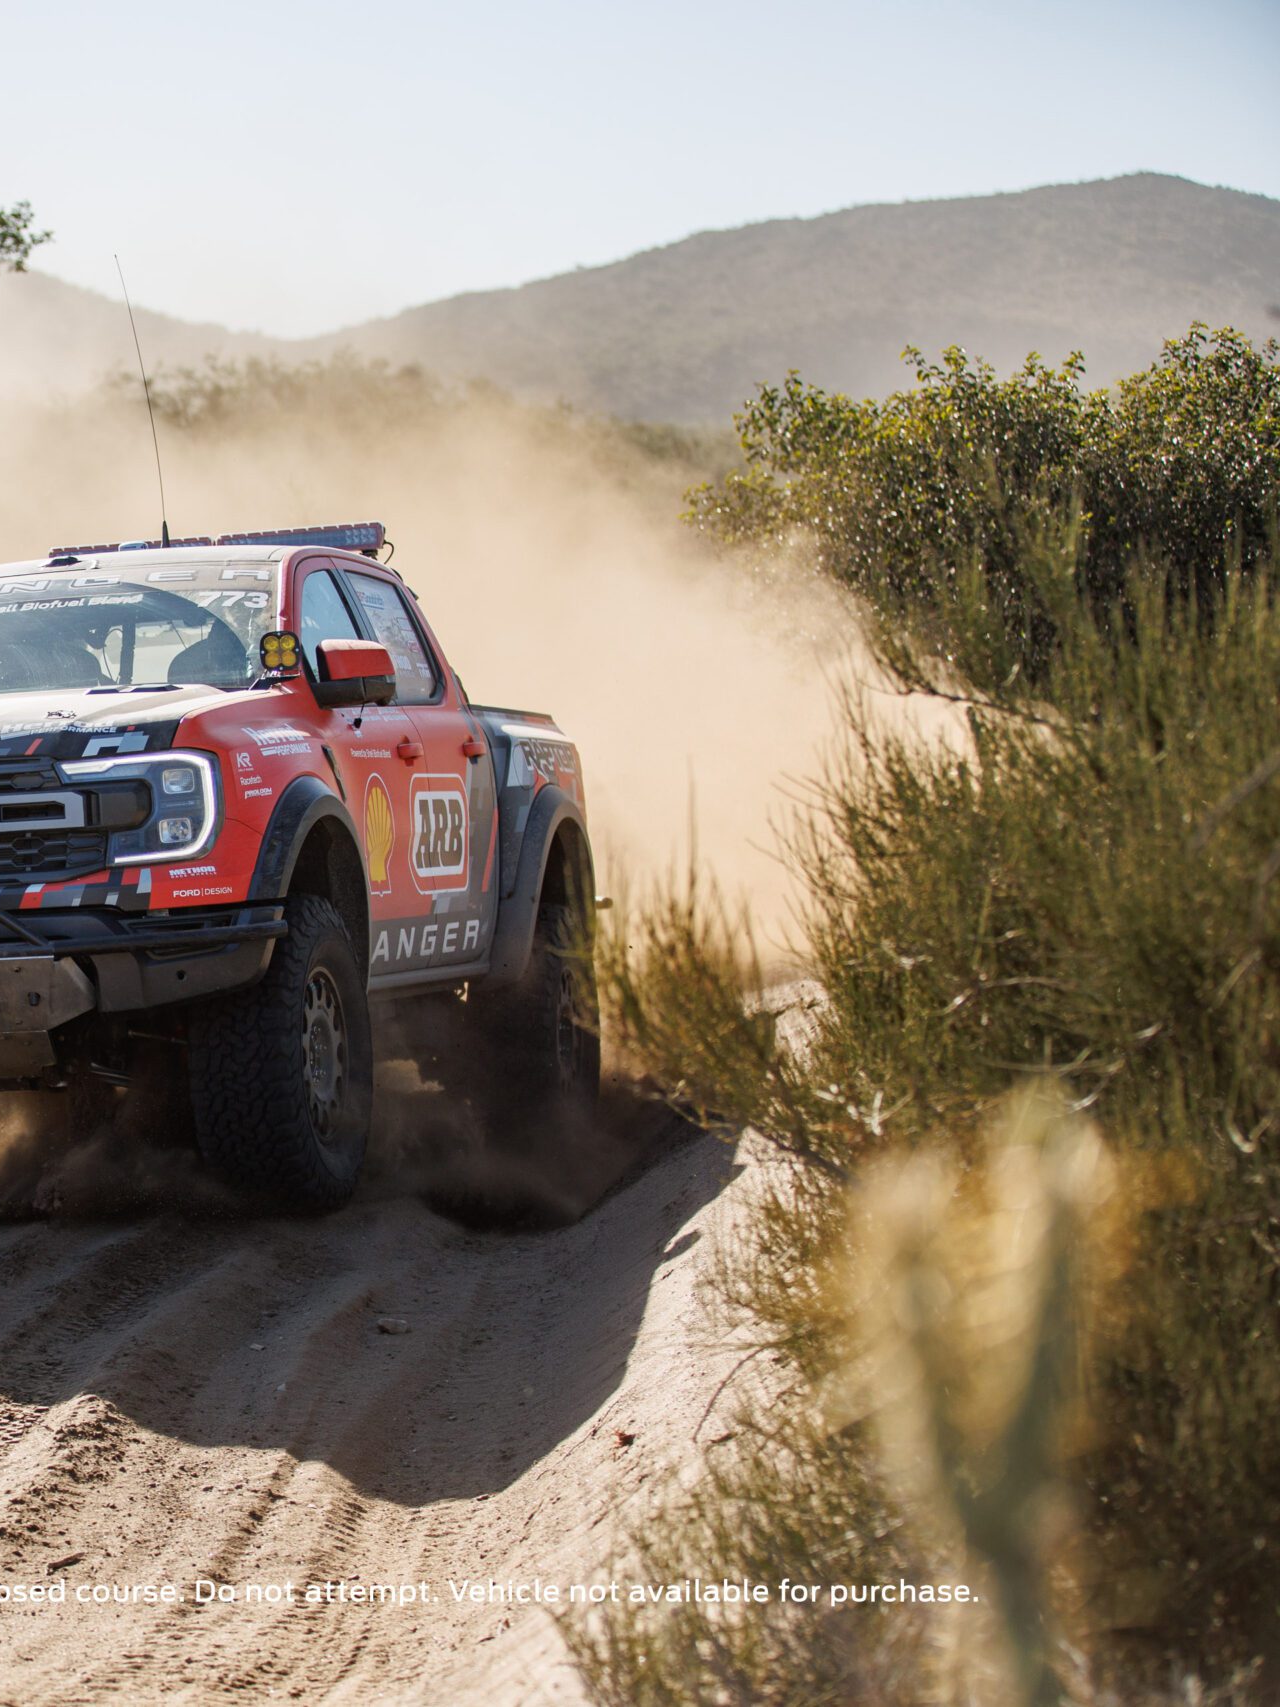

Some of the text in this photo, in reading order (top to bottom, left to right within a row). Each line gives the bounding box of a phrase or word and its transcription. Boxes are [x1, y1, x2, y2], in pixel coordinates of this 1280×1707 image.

[20, 596, 84, 612] Biofuel
[87, 593, 144, 607] Blend
[197, 591, 269, 609] 773
[30, 726, 118, 736] PERFORMANCE
[236, 752, 252, 768] KR
[415, 798, 464, 870] ARB
[168, 866, 216, 876] METHOD
[173, 887, 233, 898] FORD DESIGN
[370, 919, 480, 965] ANGER
